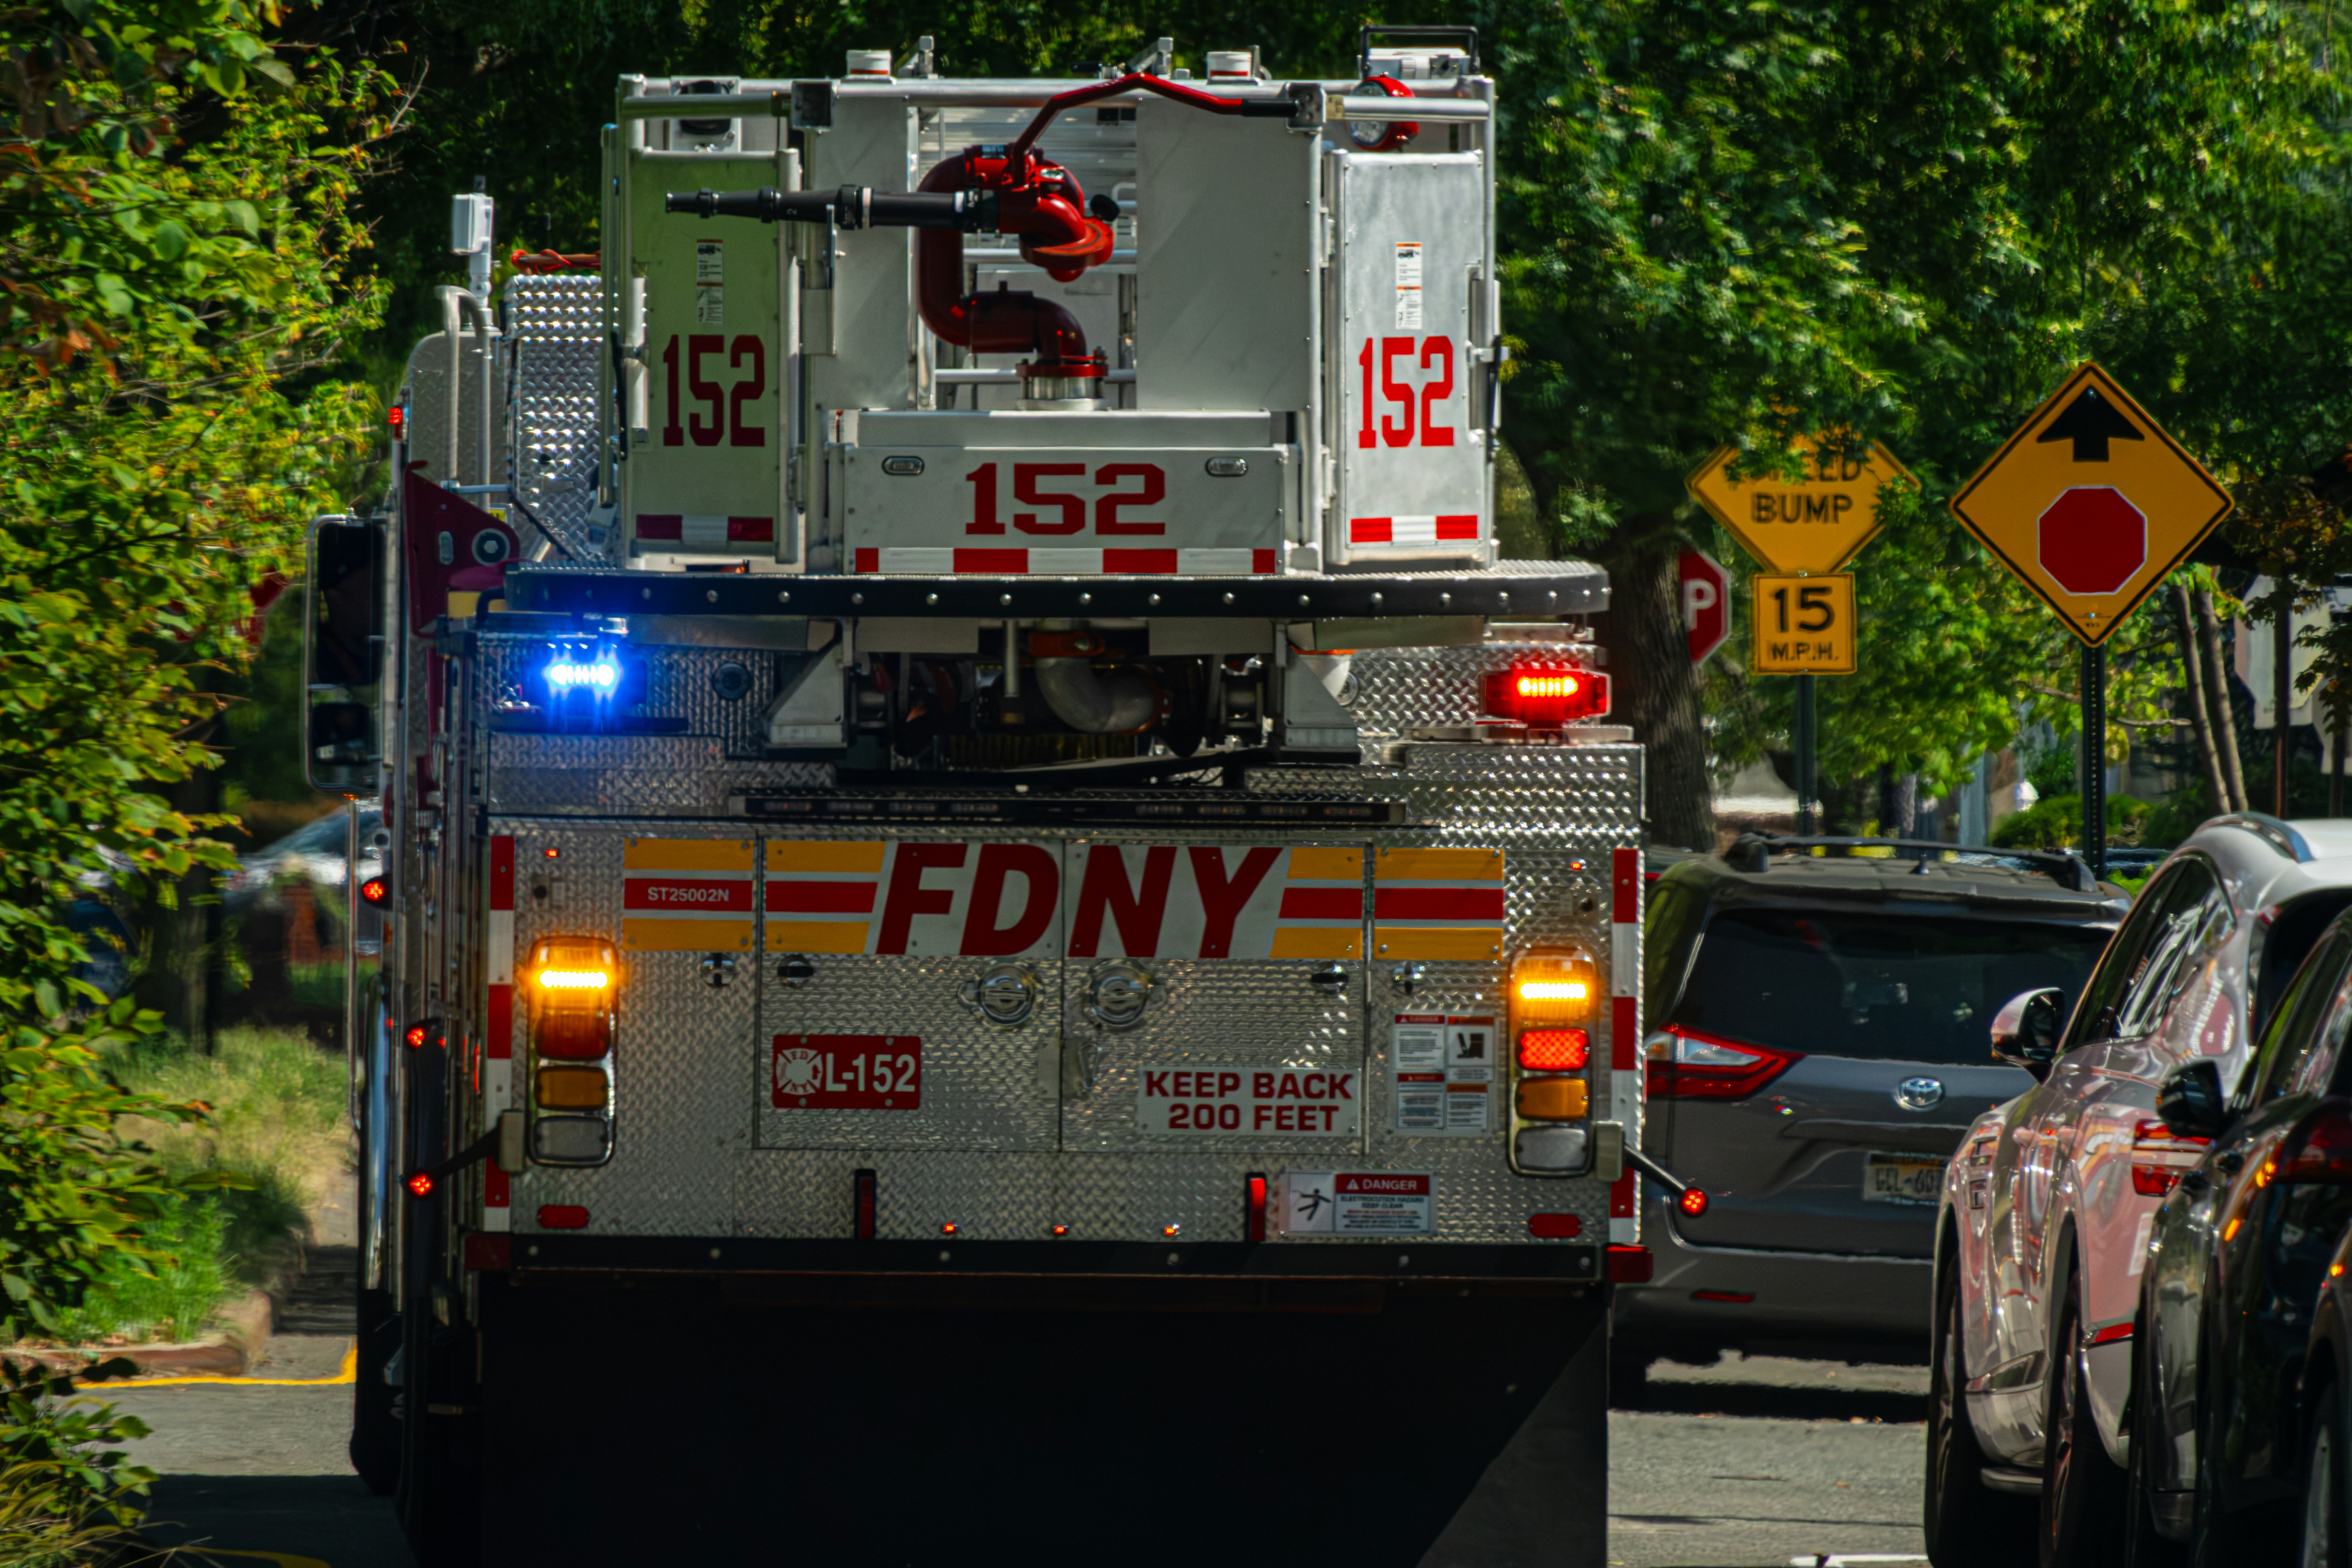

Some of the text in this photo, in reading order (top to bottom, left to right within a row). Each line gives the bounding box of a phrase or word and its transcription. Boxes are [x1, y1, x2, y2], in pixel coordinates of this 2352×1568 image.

[663, 334, 765, 447] 152
[1359, 335, 1454, 449] 152
[965, 462, 1166, 535] 152
[1753, 493, 1853, 524] BUMP
[1772, 586, 1836, 632] 15
[1770, 641, 1840, 661] M.P.H.
[648, 886, 729, 902] ST25002N
[877, 842, 1284, 959] FDNY
[825, 1052, 916, 1093] L-152
[1145, 1071, 1352, 1100] KEEP BACK
[1169, 1104, 1340, 1132] 200 FEET
[1362, 1179, 1417, 1190] DANGER
